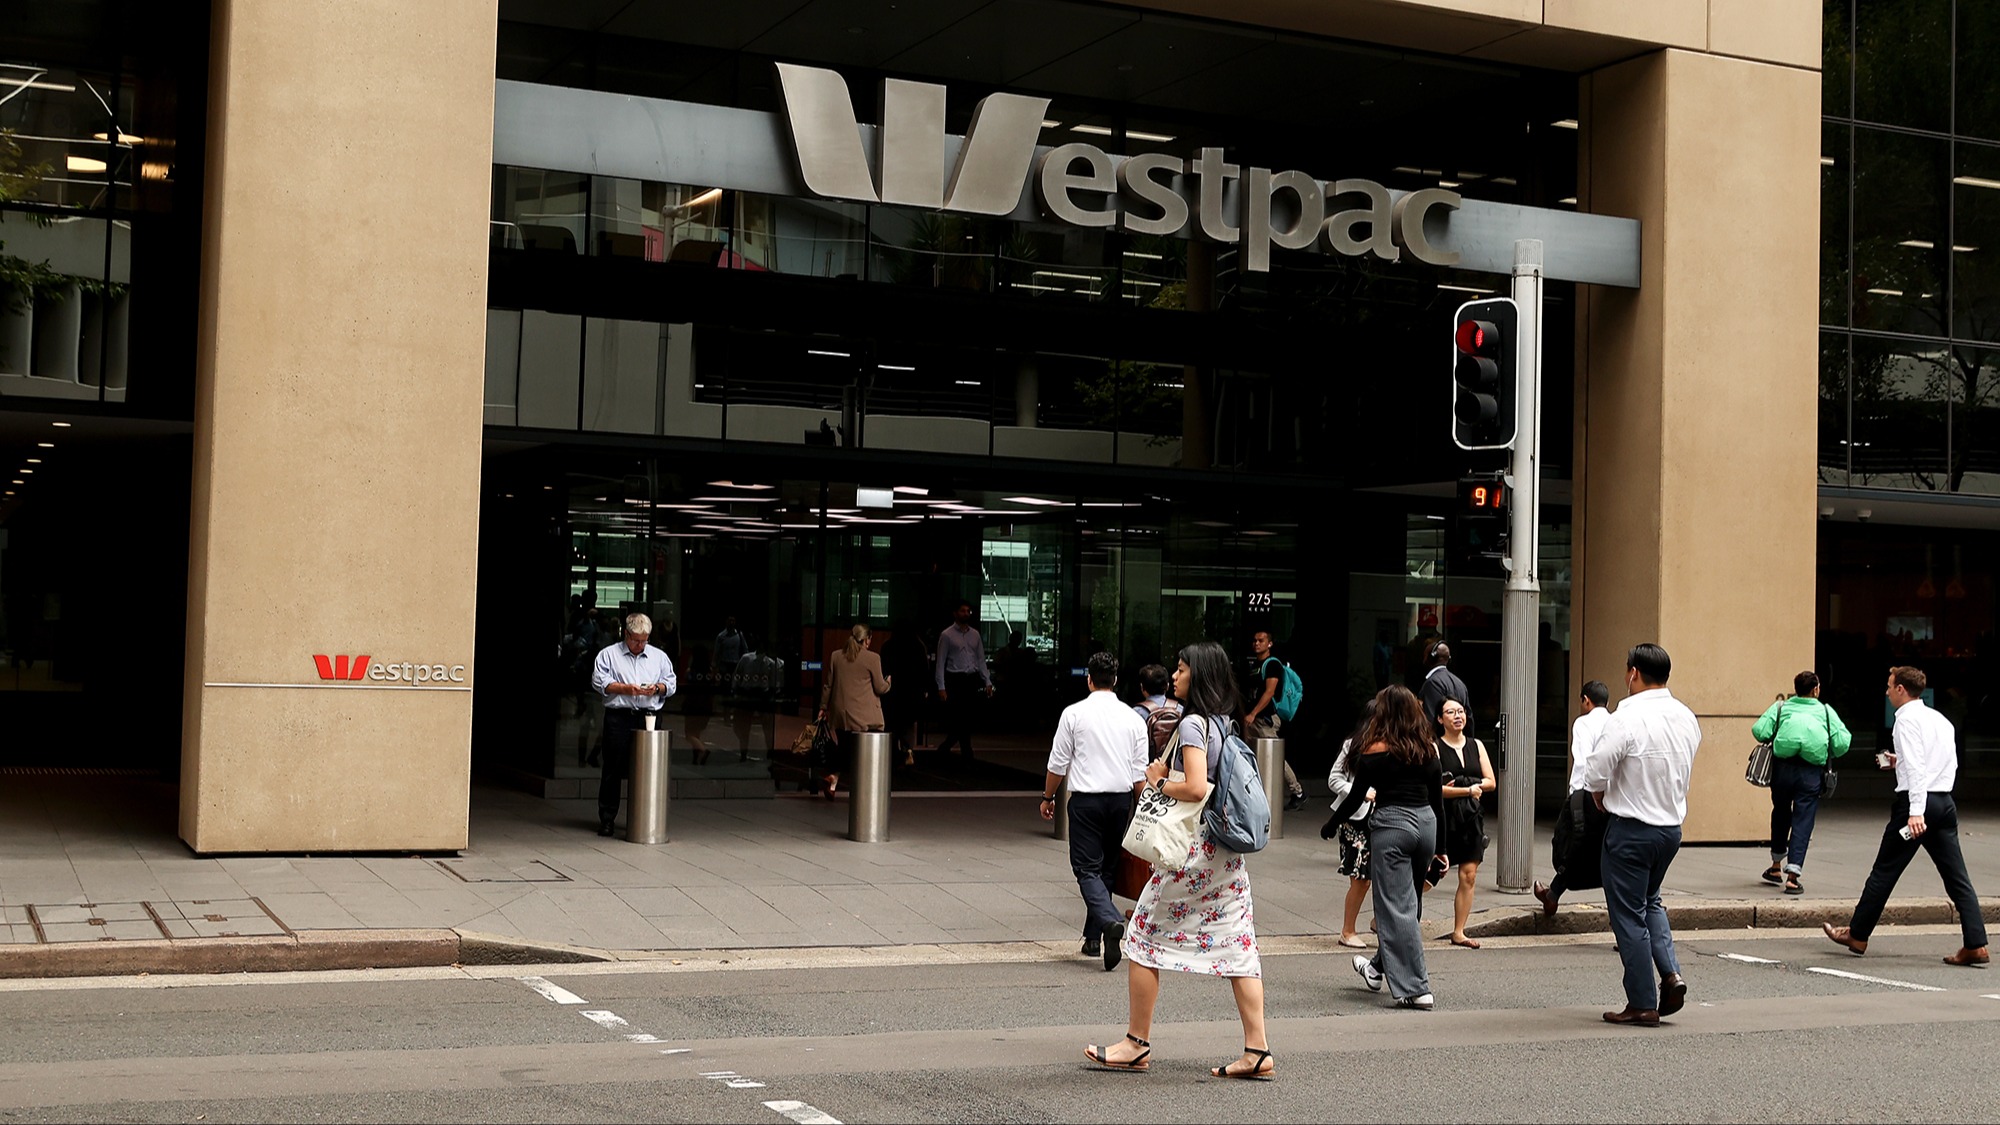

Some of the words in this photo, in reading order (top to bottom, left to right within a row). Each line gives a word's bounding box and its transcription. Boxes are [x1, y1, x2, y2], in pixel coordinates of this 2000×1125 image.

[774, 62, 1461, 272] Westpac
[1248, 593, 1271, 606] 275
[313, 655, 465, 686] Westpac
[1142, 787, 1178, 807] GOOD
